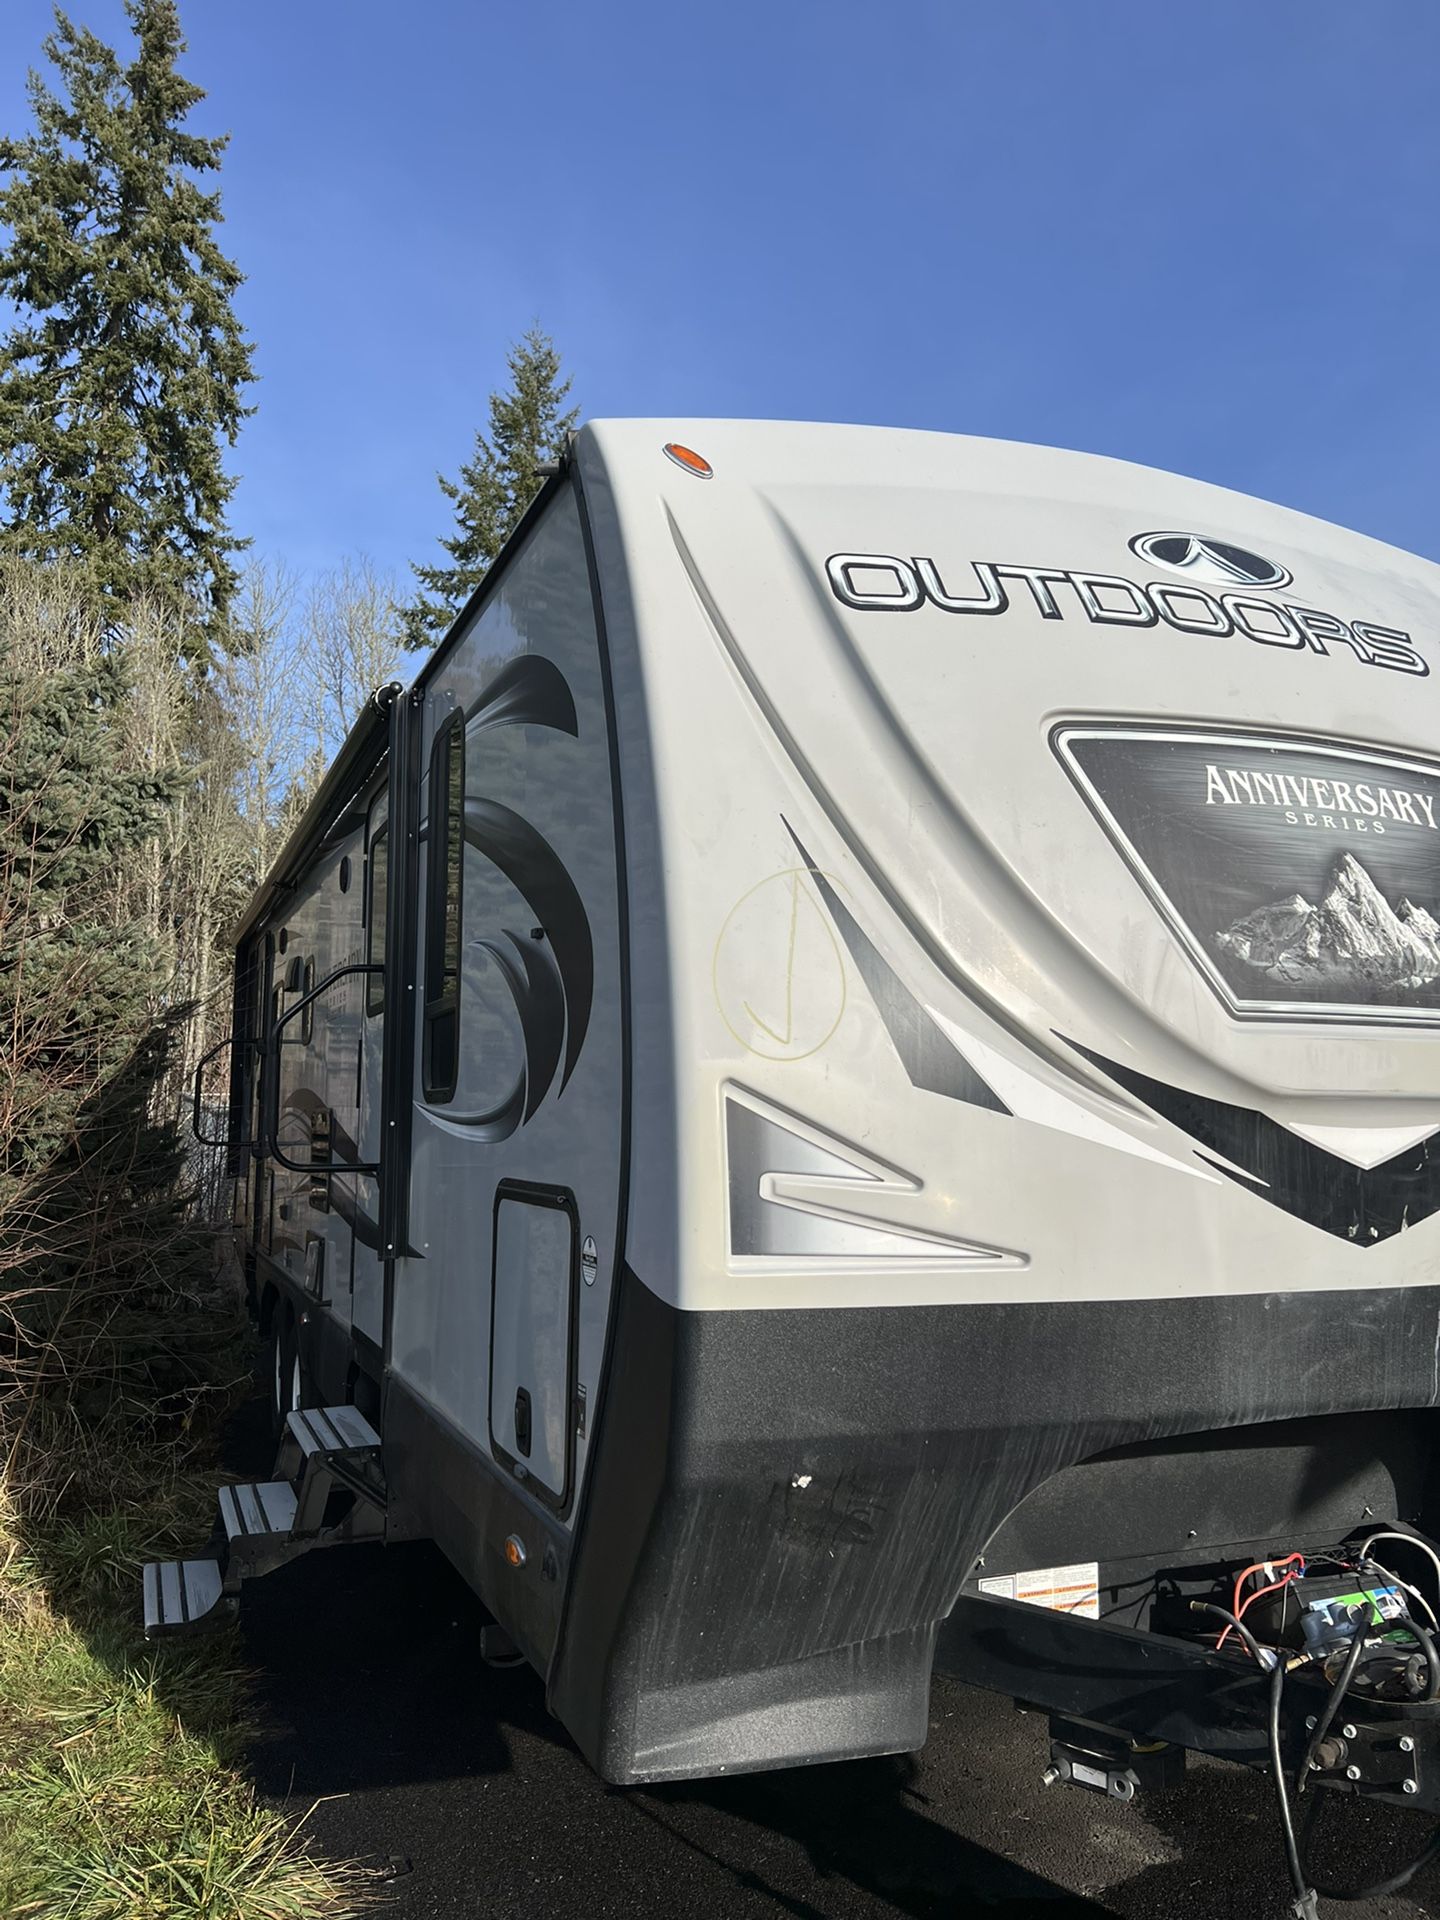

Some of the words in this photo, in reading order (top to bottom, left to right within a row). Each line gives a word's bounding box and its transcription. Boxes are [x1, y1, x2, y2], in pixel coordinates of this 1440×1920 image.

[825, 553, 1430, 677] OUTDOORS
[1206, 765, 1438, 829] ANNIVERSARY
[1285, 811, 1386, 834] SERIES
